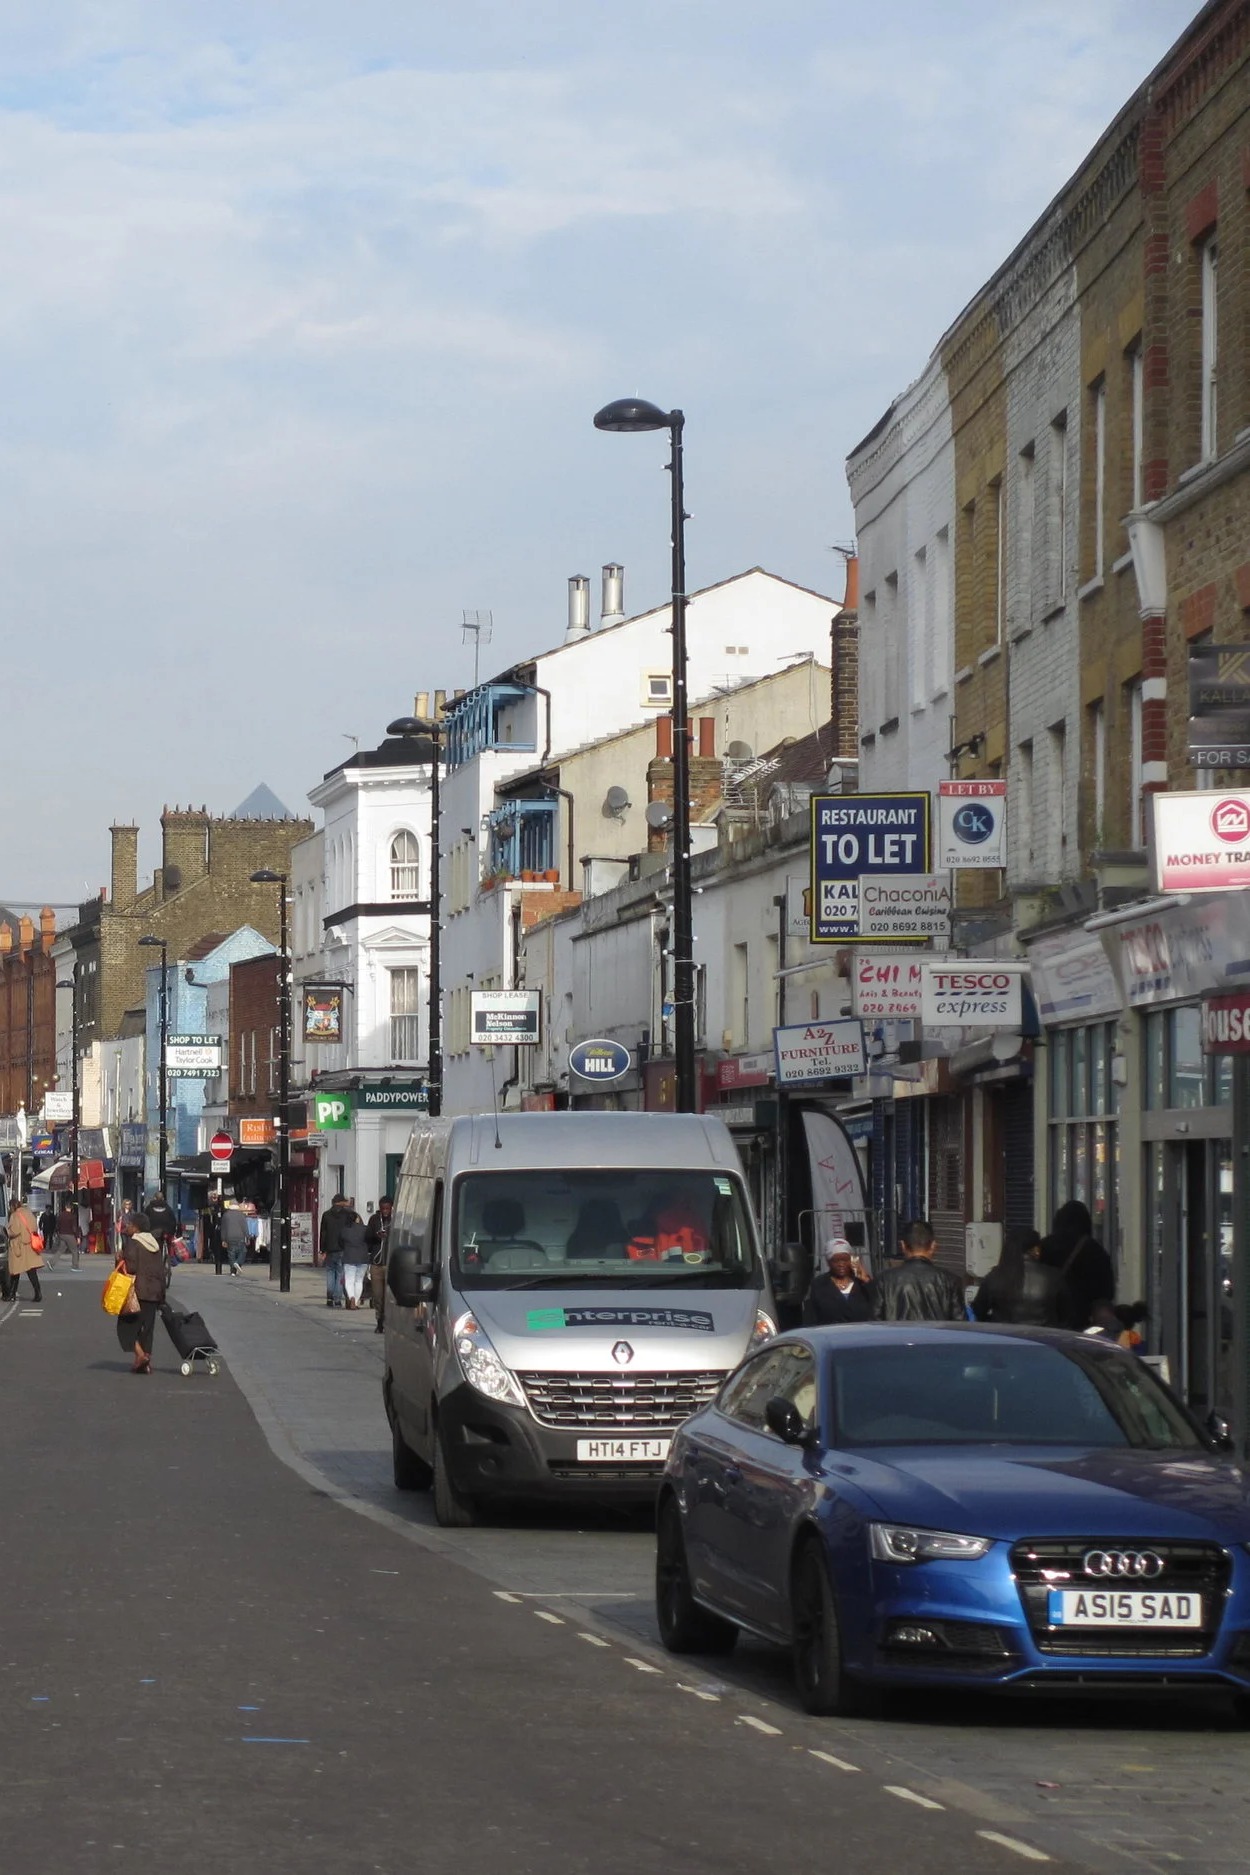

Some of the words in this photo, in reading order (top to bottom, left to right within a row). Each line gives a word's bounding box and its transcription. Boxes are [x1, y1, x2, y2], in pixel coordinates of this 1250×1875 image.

[1199, 688, 1250, 703] KALLA
[1198, 751, 1231, 764] FOR
[1237, 751, 1250, 764] S
[949, 784, 975, 795] LET
[978, 784, 996, 795] BY
[821, 808, 917, 826] RESTAURANT
[821, 833, 860, 865] TO
[868, 833, 917, 864] LET
[946, 856, 960, 864] 020
[1166, 852, 1222, 866] MONEY
[824, 884, 858, 900] KAL
[824, 905, 847, 917] 020
[869, 906, 912, 917] Caribbean
[870, 922, 889, 931] 020
[892, 922, 917, 931] 8692
[921, 922, 946, 931] 8815
[859, 965, 900, 984] CHI
[933, 974, 1010, 989] TESCO
[862, 1003, 884, 1012] 020
[937, 999, 1007, 1017] express
[169, 1036, 190, 1044] SHOP
[191, 1036, 202, 1044] TO
[204, 1036, 219, 1044] LET
[803, 1027, 835, 1046] A2Z
[175, 1047, 203, 1055] Hartnell
[781, 1043, 860, 1061] FURNITURE
[585, 1058, 615, 1072] HILL
[810, 1056, 832, 1067] Tel.
[167, 1069, 181, 1077] 020
[183, 1069, 200, 1077] 7491
[202, 1069, 220, 1077] 7323
[785, 1069, 804, 1079] 020
[806, 1066, 832, 1077] 8692
[834, 1064, 859, 1074] 9332
[541, 1310, 712, 1326] enterprise
[648, 1319, 711, 1331] rent-a-car
[589, 1441, 625, 1457] HT14
[630, 1441, 661, 1457] FTJ
[1075, 1594, 1132, 1619] AS15
[1141, 1595, 1191, 1620] SAD
